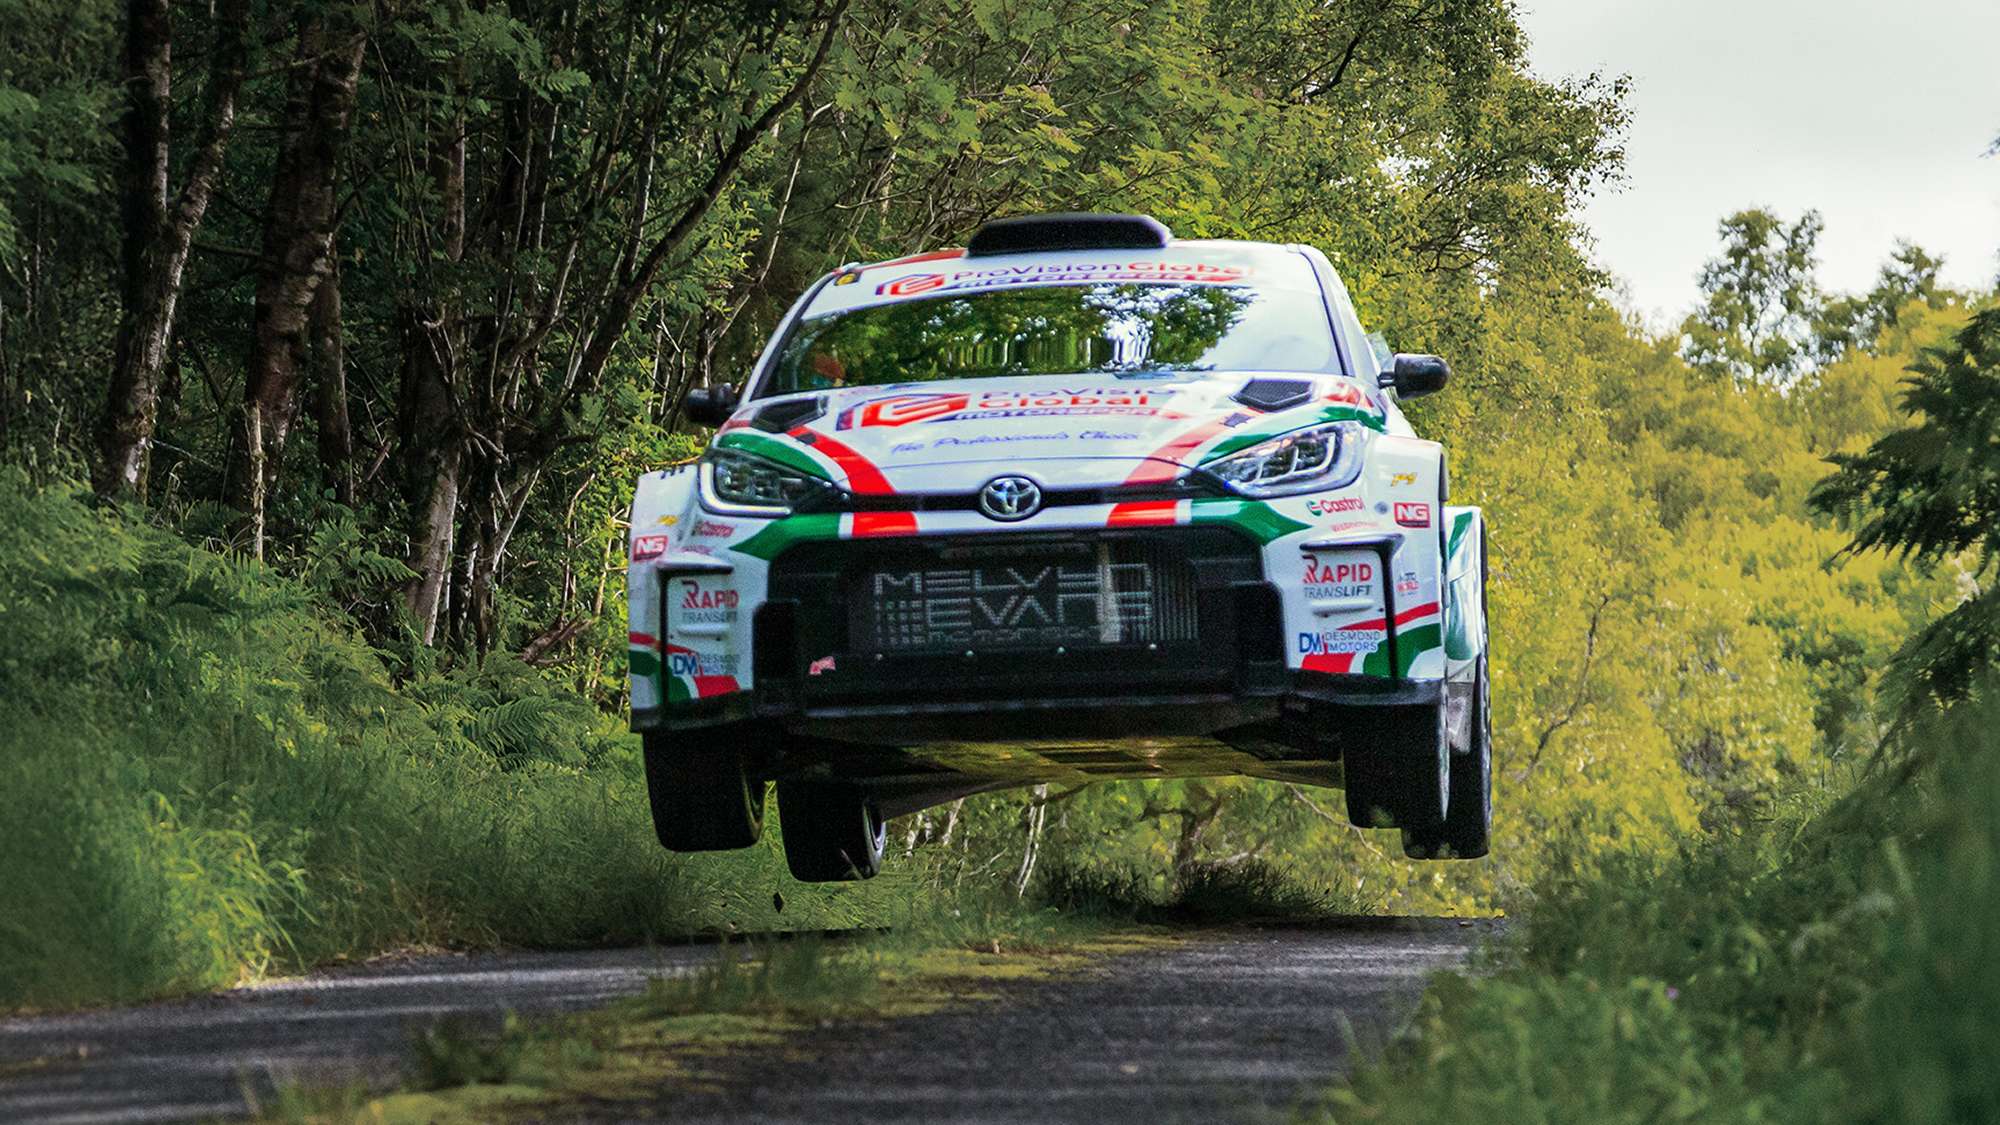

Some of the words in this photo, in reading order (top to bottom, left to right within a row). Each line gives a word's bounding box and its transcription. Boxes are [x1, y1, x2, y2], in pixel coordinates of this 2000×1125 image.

[953, 260, 1122, 281] ProVision
[978, 395, 1150, 409] Global
[1320, 497, 1365, 514] Castrol
[1398, 504, 1428, 521] NG
[636, 538, 665, 555] NG
[1302, 554, 1373, 584] RAPID
[1303, 585, 1373, 600] TRANSLIFT
[1324, 630, 1381, 642] DESMOND
[1329, 642, 1377, 653] MOTORS
